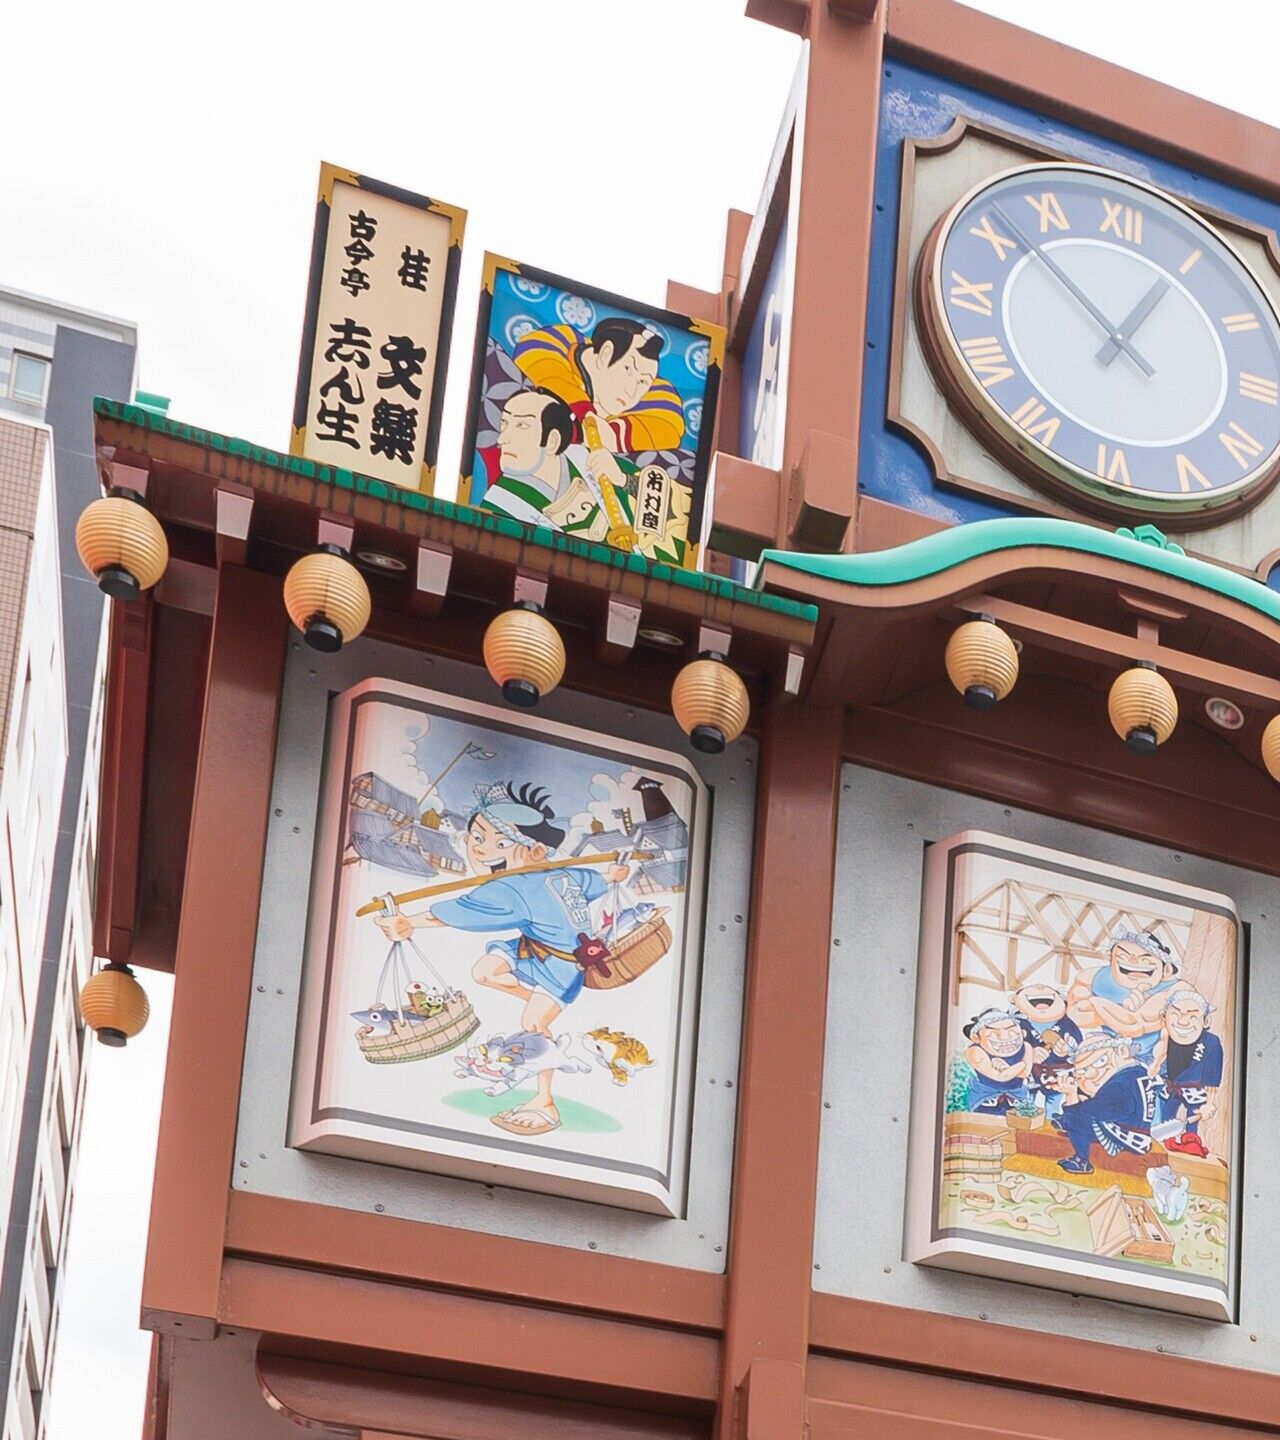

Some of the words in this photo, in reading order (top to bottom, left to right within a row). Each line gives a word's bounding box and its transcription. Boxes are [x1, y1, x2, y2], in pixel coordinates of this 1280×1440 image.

[970, 216, 1017, 261] X
[1100, 198, 1143, 244] XII
[950, 271, 993, 316] IX
